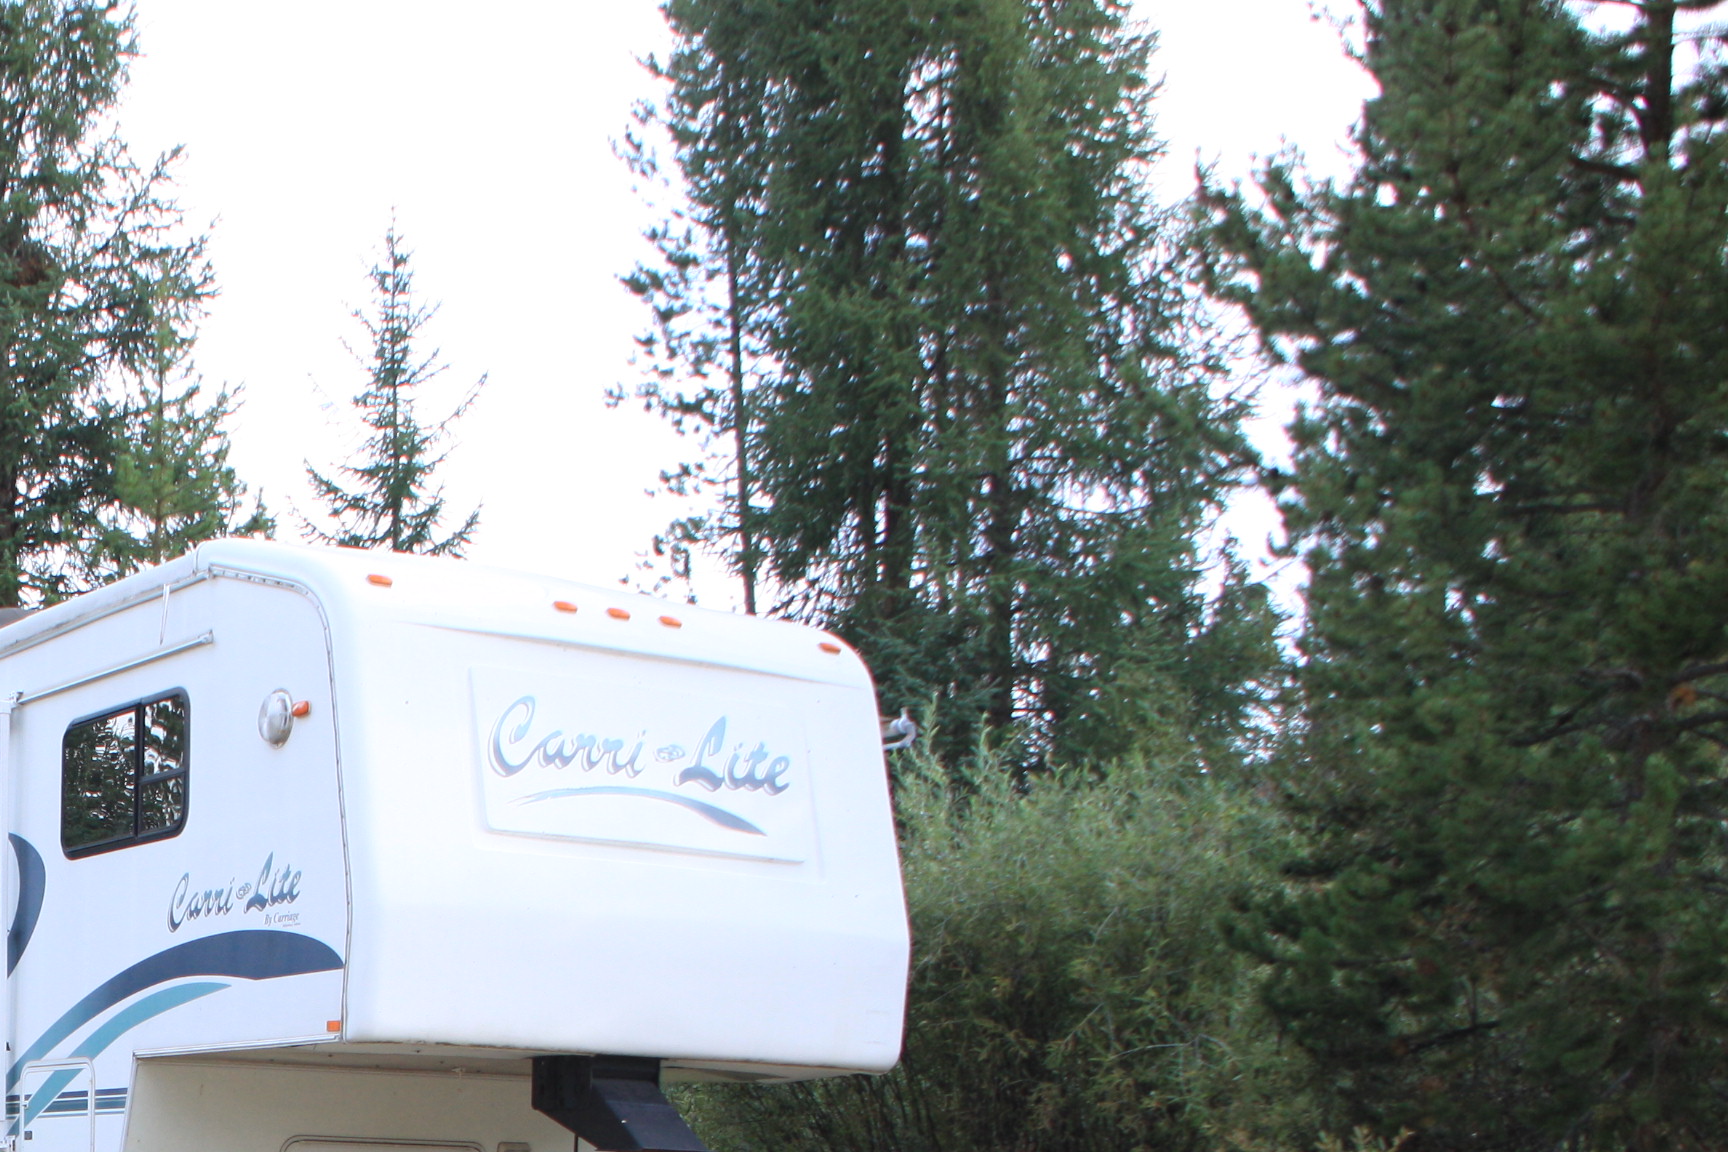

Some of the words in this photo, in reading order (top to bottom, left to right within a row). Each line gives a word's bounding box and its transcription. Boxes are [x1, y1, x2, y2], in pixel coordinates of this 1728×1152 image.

[488, 695, 646, 777] Carri
[673, 715, 791, 795] Lite
[167, 872, 235, 933] Carri
[243, 850, 302, 914] Lite
